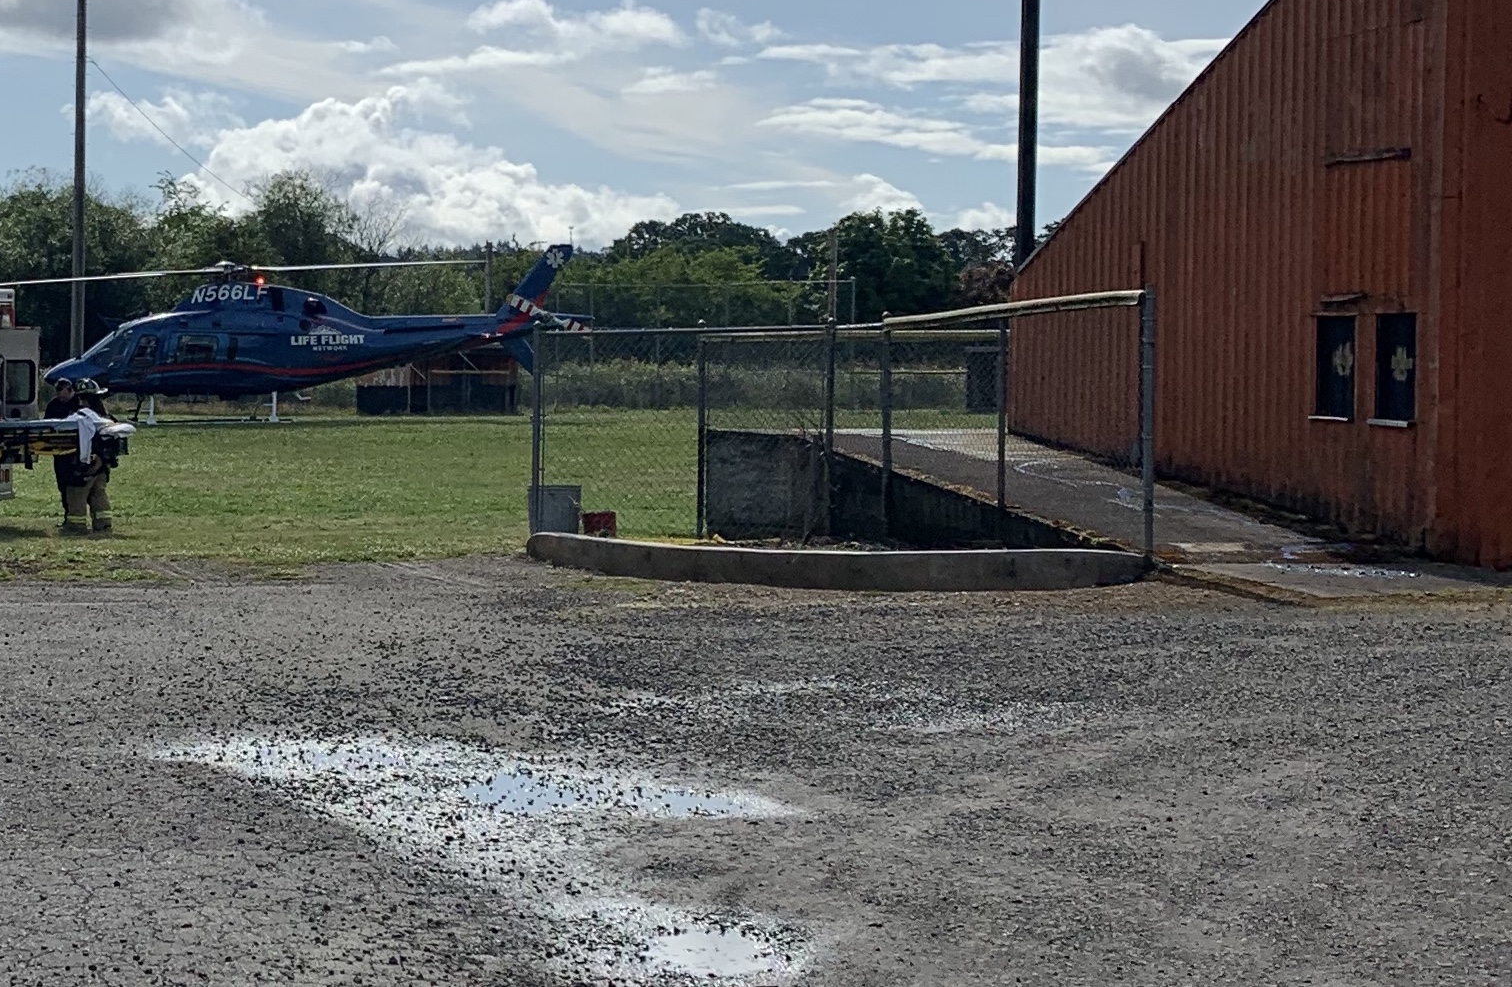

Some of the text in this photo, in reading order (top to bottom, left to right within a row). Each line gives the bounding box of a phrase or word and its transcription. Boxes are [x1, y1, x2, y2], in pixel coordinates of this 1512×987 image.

[190, 284, 270, 304] N566LF
[290, 334, 365, 346] LIFE FLIGHT
